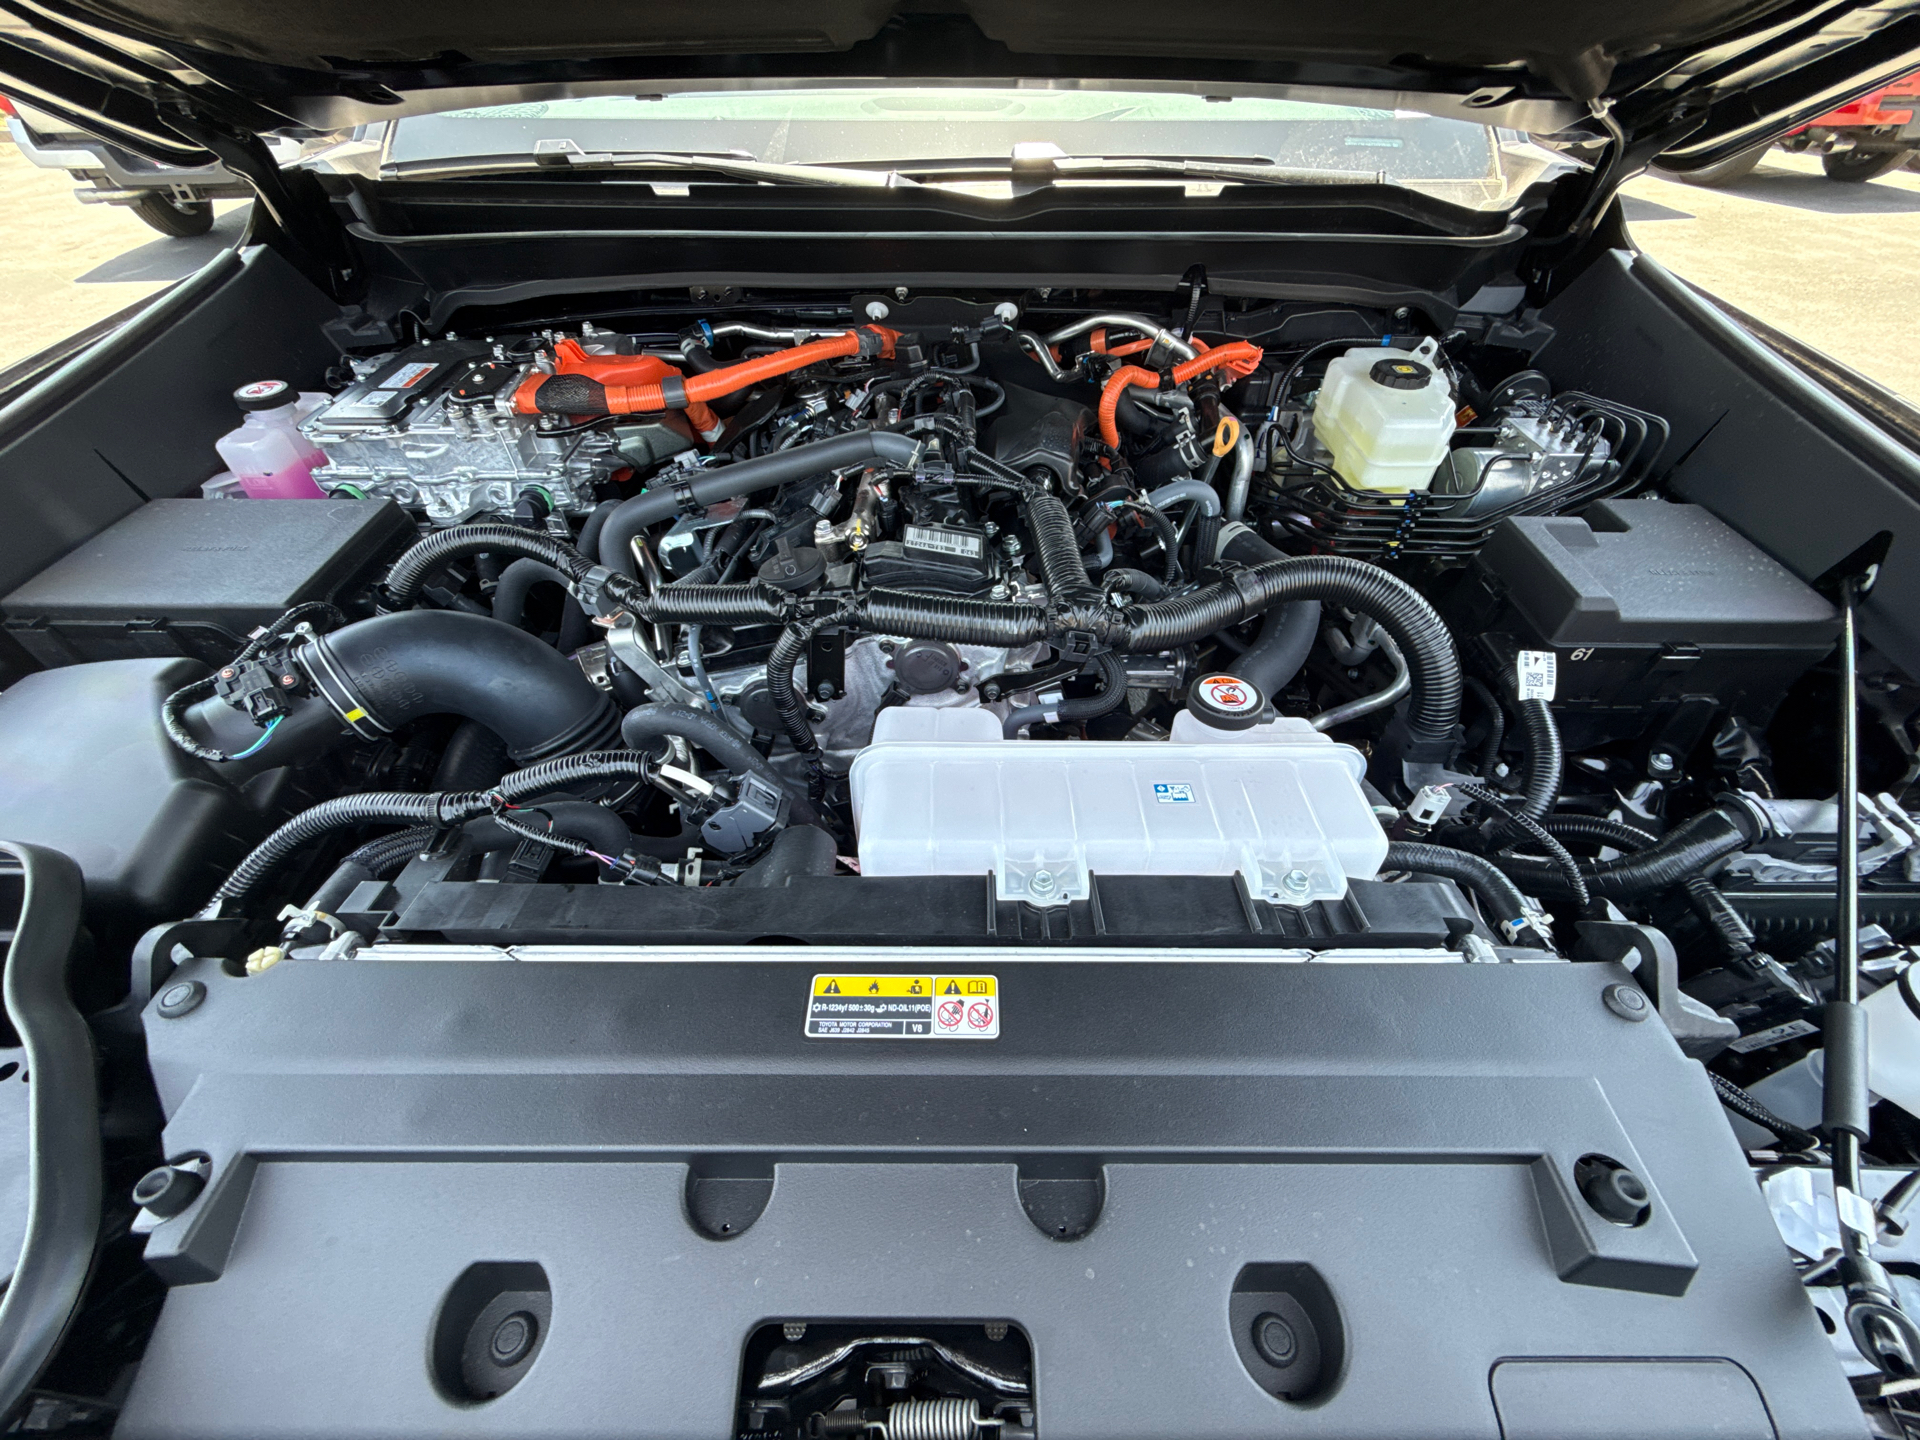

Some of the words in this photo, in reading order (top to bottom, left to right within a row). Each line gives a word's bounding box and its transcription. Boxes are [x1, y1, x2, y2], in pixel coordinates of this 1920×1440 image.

[1570, 647, 1595, 661] 61
[821, 1003, 847, 1013] R-1234yf
[848, 1004, 875, 1013] 500±30g
[888, 1004, 931, 1013] ND-OIL11(POE)
[912, 1023, 923, 1033] V8
